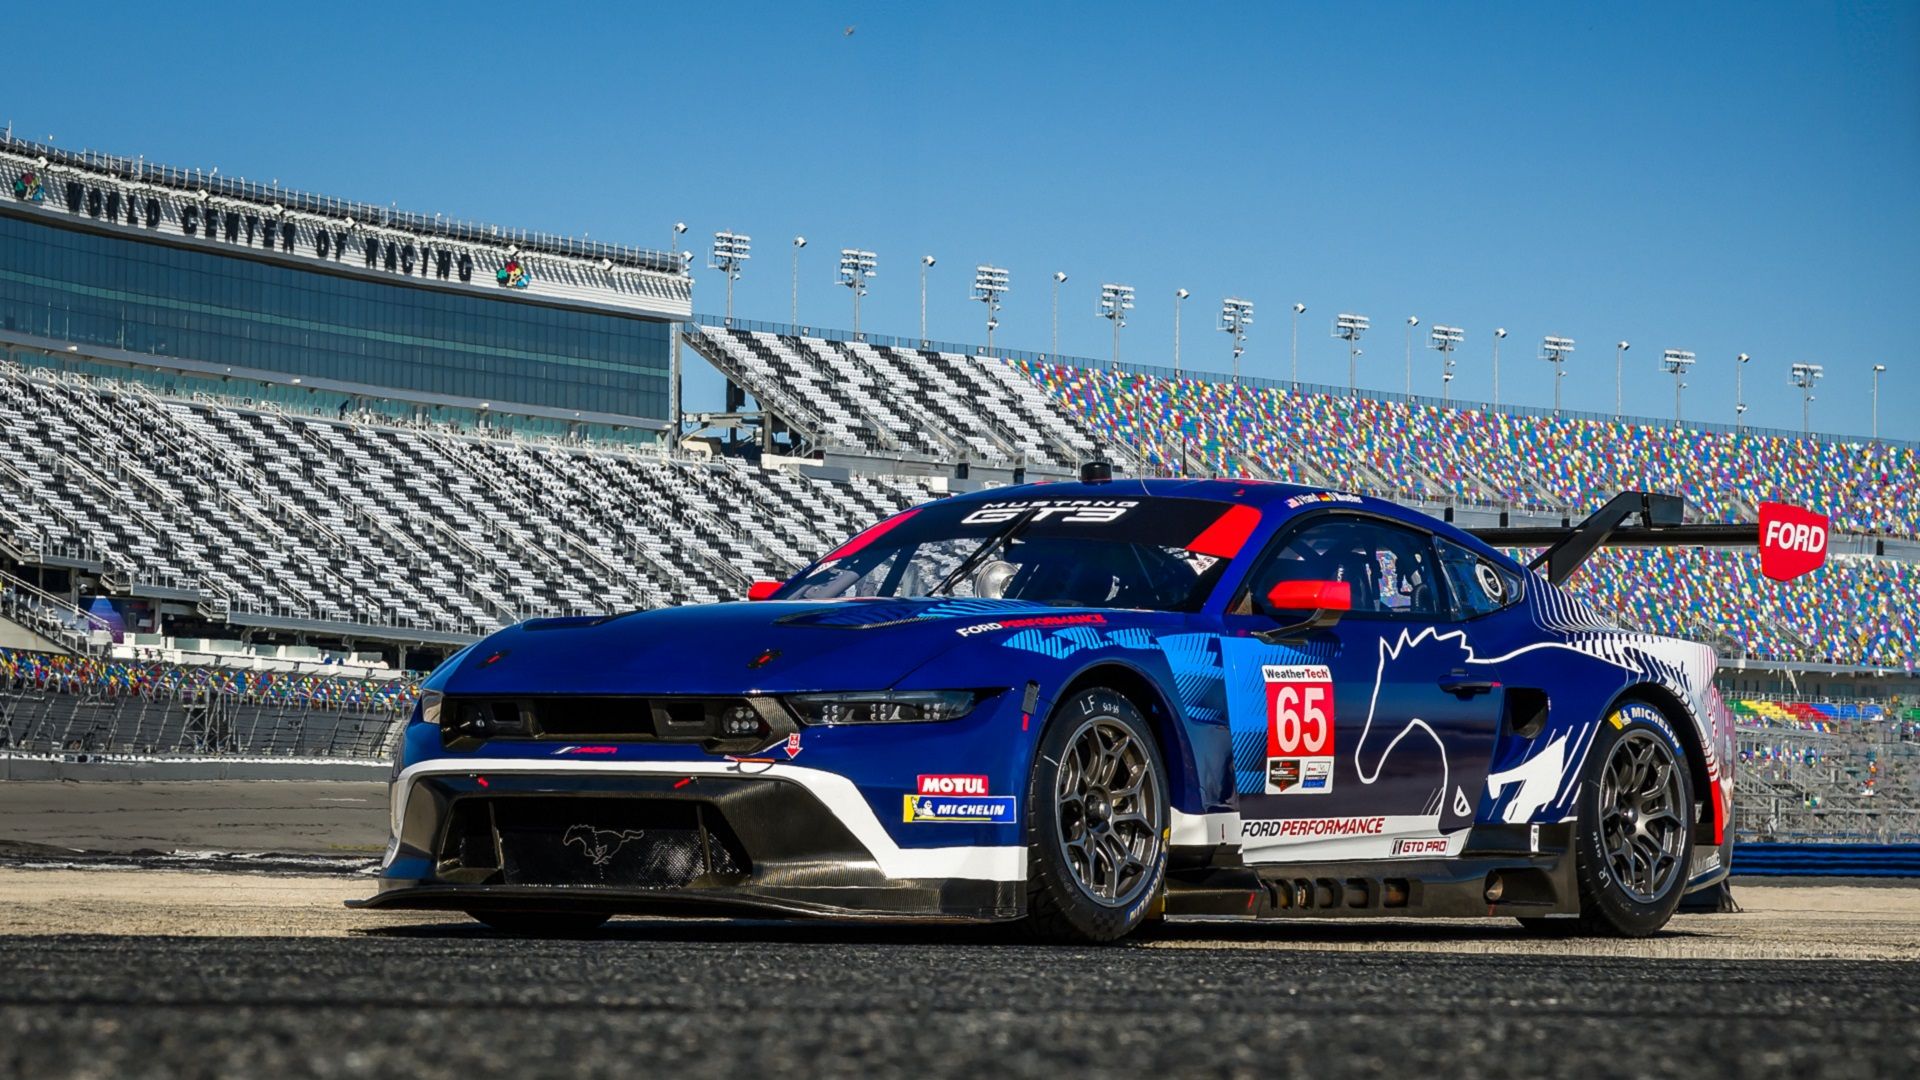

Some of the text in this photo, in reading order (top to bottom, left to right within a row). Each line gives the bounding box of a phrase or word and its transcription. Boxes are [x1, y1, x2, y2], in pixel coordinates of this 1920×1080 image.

[66, 181, 475, 283] WORLD CENTER OF RACING
[981, 500, 1140, 509] MUSTANG
[961, 506, 1128, 524] GT3
[1765, 520, 1826, 553] FORD
[1265, 668, 1328, 679] WeatherTech
[1276, 686, 1327, 753] 65
[1631, 707, 1680, 749] MICHELIN
[922, 777, 985, 794] MOTUL
[937, 804, 1005, 816] MICHELIN
[1402, 840, 1447, 853] GTD PRO
